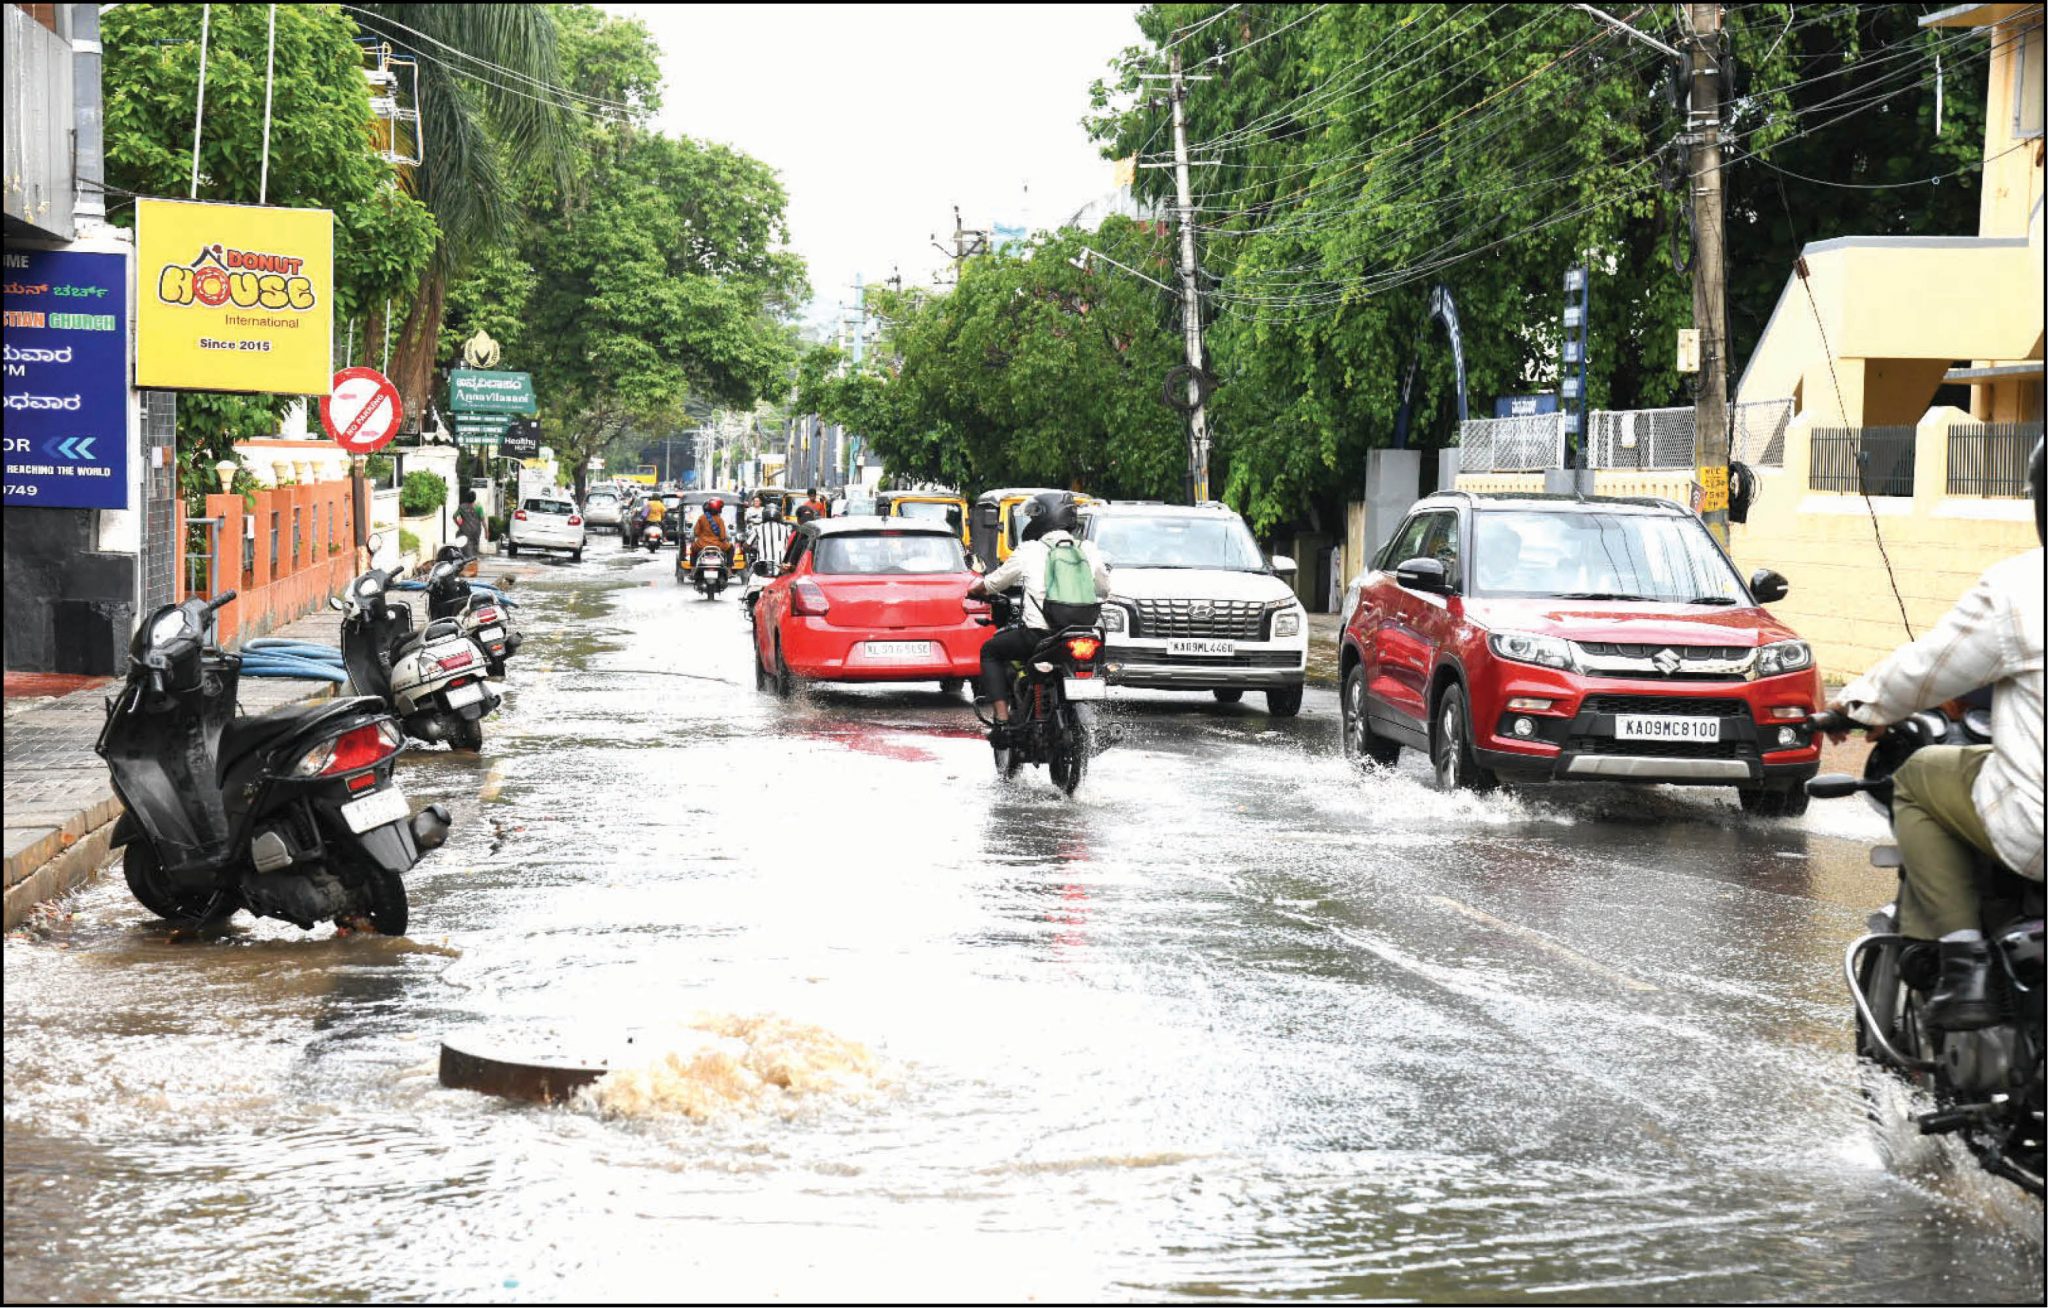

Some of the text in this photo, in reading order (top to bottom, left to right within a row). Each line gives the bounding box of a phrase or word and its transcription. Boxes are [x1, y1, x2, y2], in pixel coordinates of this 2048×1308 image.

[227, 249, 303, 275] DONUT
[159, 265, 315, 309] HOUSE
[49, 312, 116, 331] CHURCH
[225, 314, 299, 329] International
[200, 338, 270, 351] Since 2015
[4, 364, 25, 376] M
[346, 393, 384, 436] NO PARKING
[504, 437, 536, 449] Healthy
[6, 464, 111, 477] REACHING THE WORLD
[4, 484, 38, 496] 749
[1626, 720, 1717, 738] KA09MC8100
